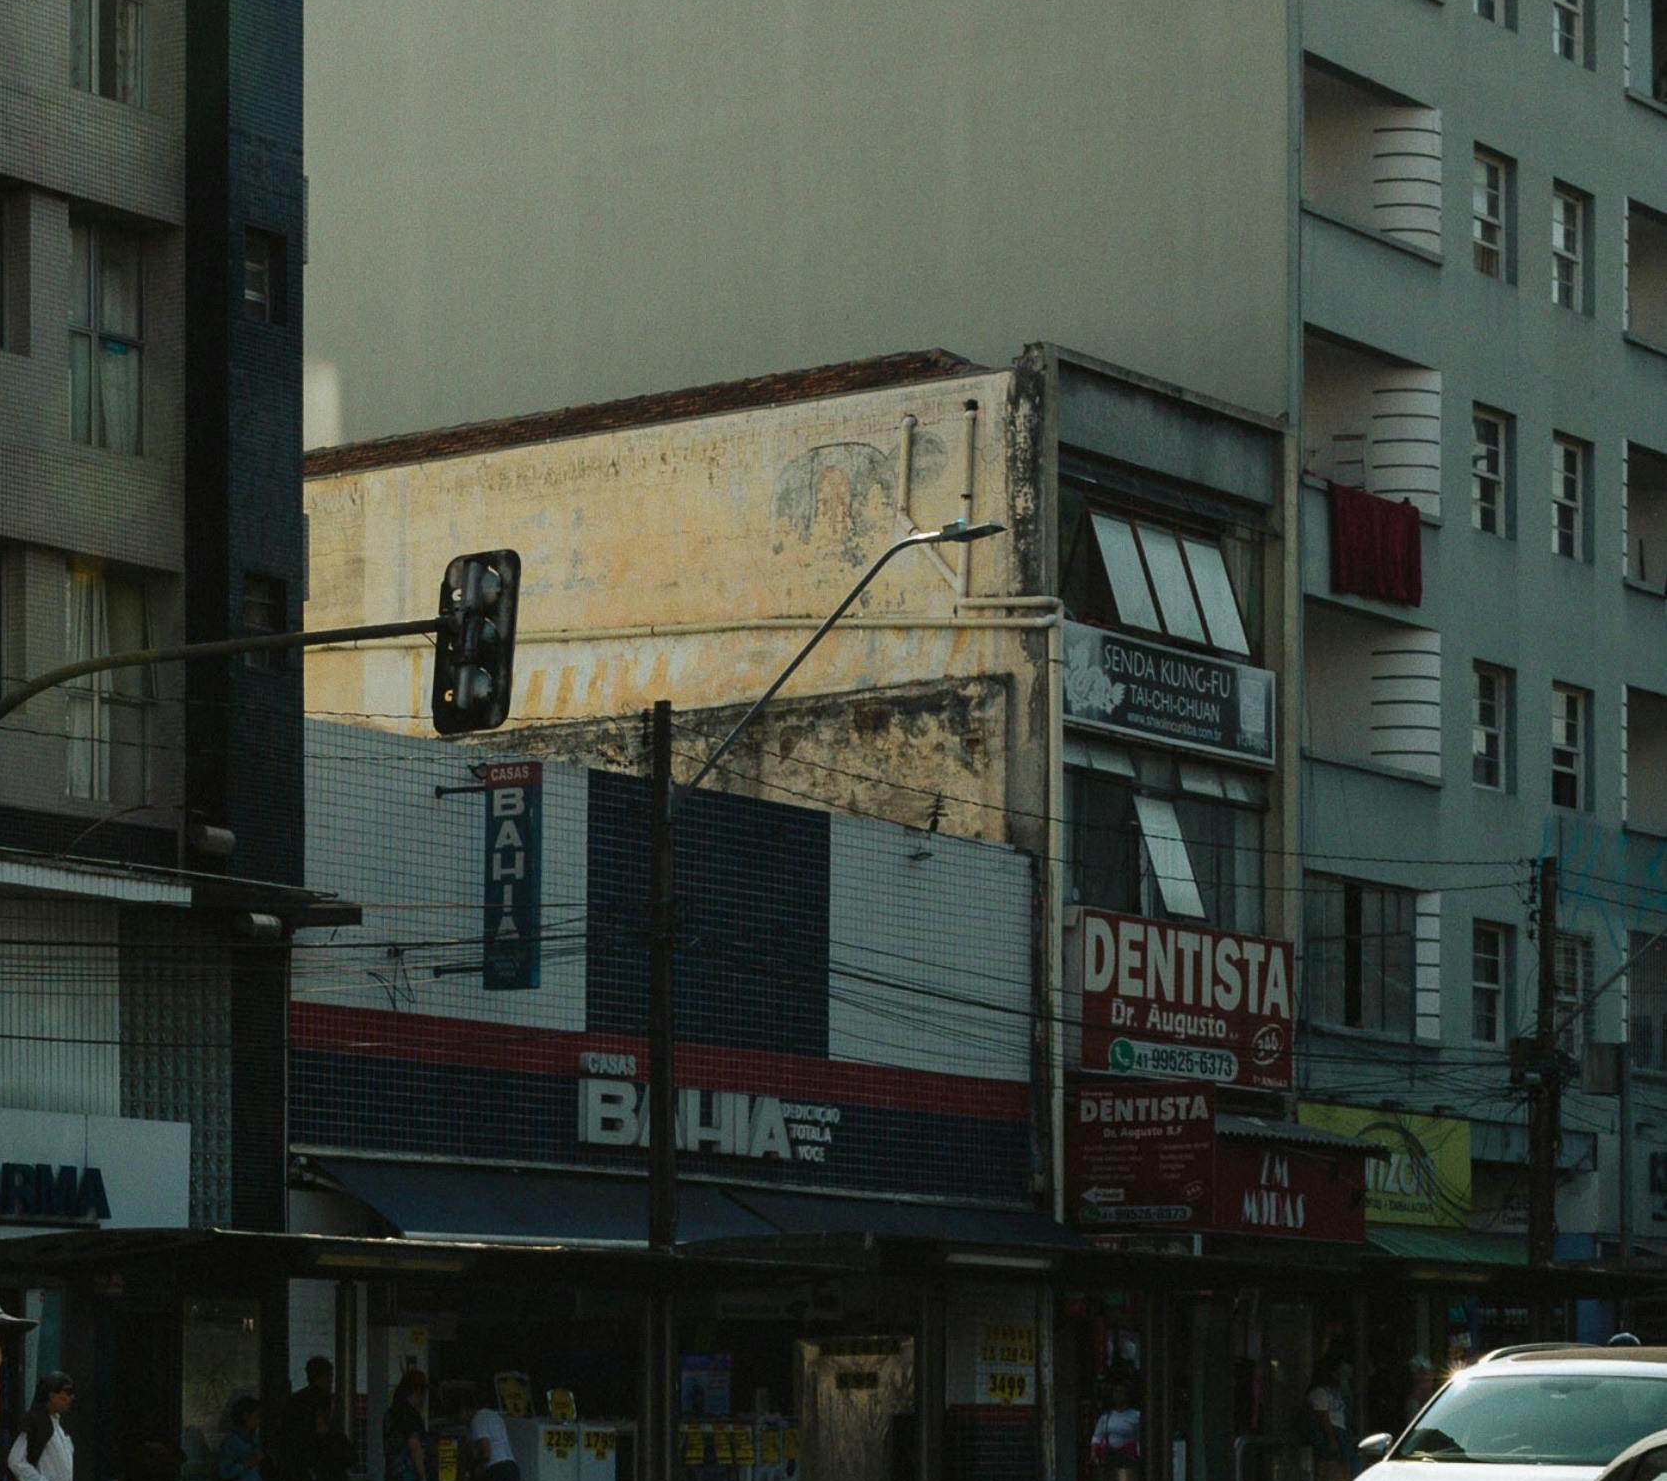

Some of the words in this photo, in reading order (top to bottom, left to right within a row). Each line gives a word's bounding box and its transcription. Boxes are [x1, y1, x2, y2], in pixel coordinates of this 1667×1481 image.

[1104, 644, 1156, 680] SENDA
[1160, 658, 1230, 699] KUNG-FU
[1129, 684, 1221, 723] TAI-CHI-CHUAN
[490, 765, 530, 781] CASAS
[492, 786, 526, 940] BAHIA
[1084, 916, 1291, 1020] DENTISTA
[1110, 998, 1138, 1028] Dr.
[1146, 1003, 1227, 1041] Augusto
[582, 1052, 637, 1076] CASAS
[1079, 1095, 1209, 1123] DENTISTA
[1120, 1127, 1164, 1140] Augusto
[1241, 1189, 1306, 1229] MODAS
